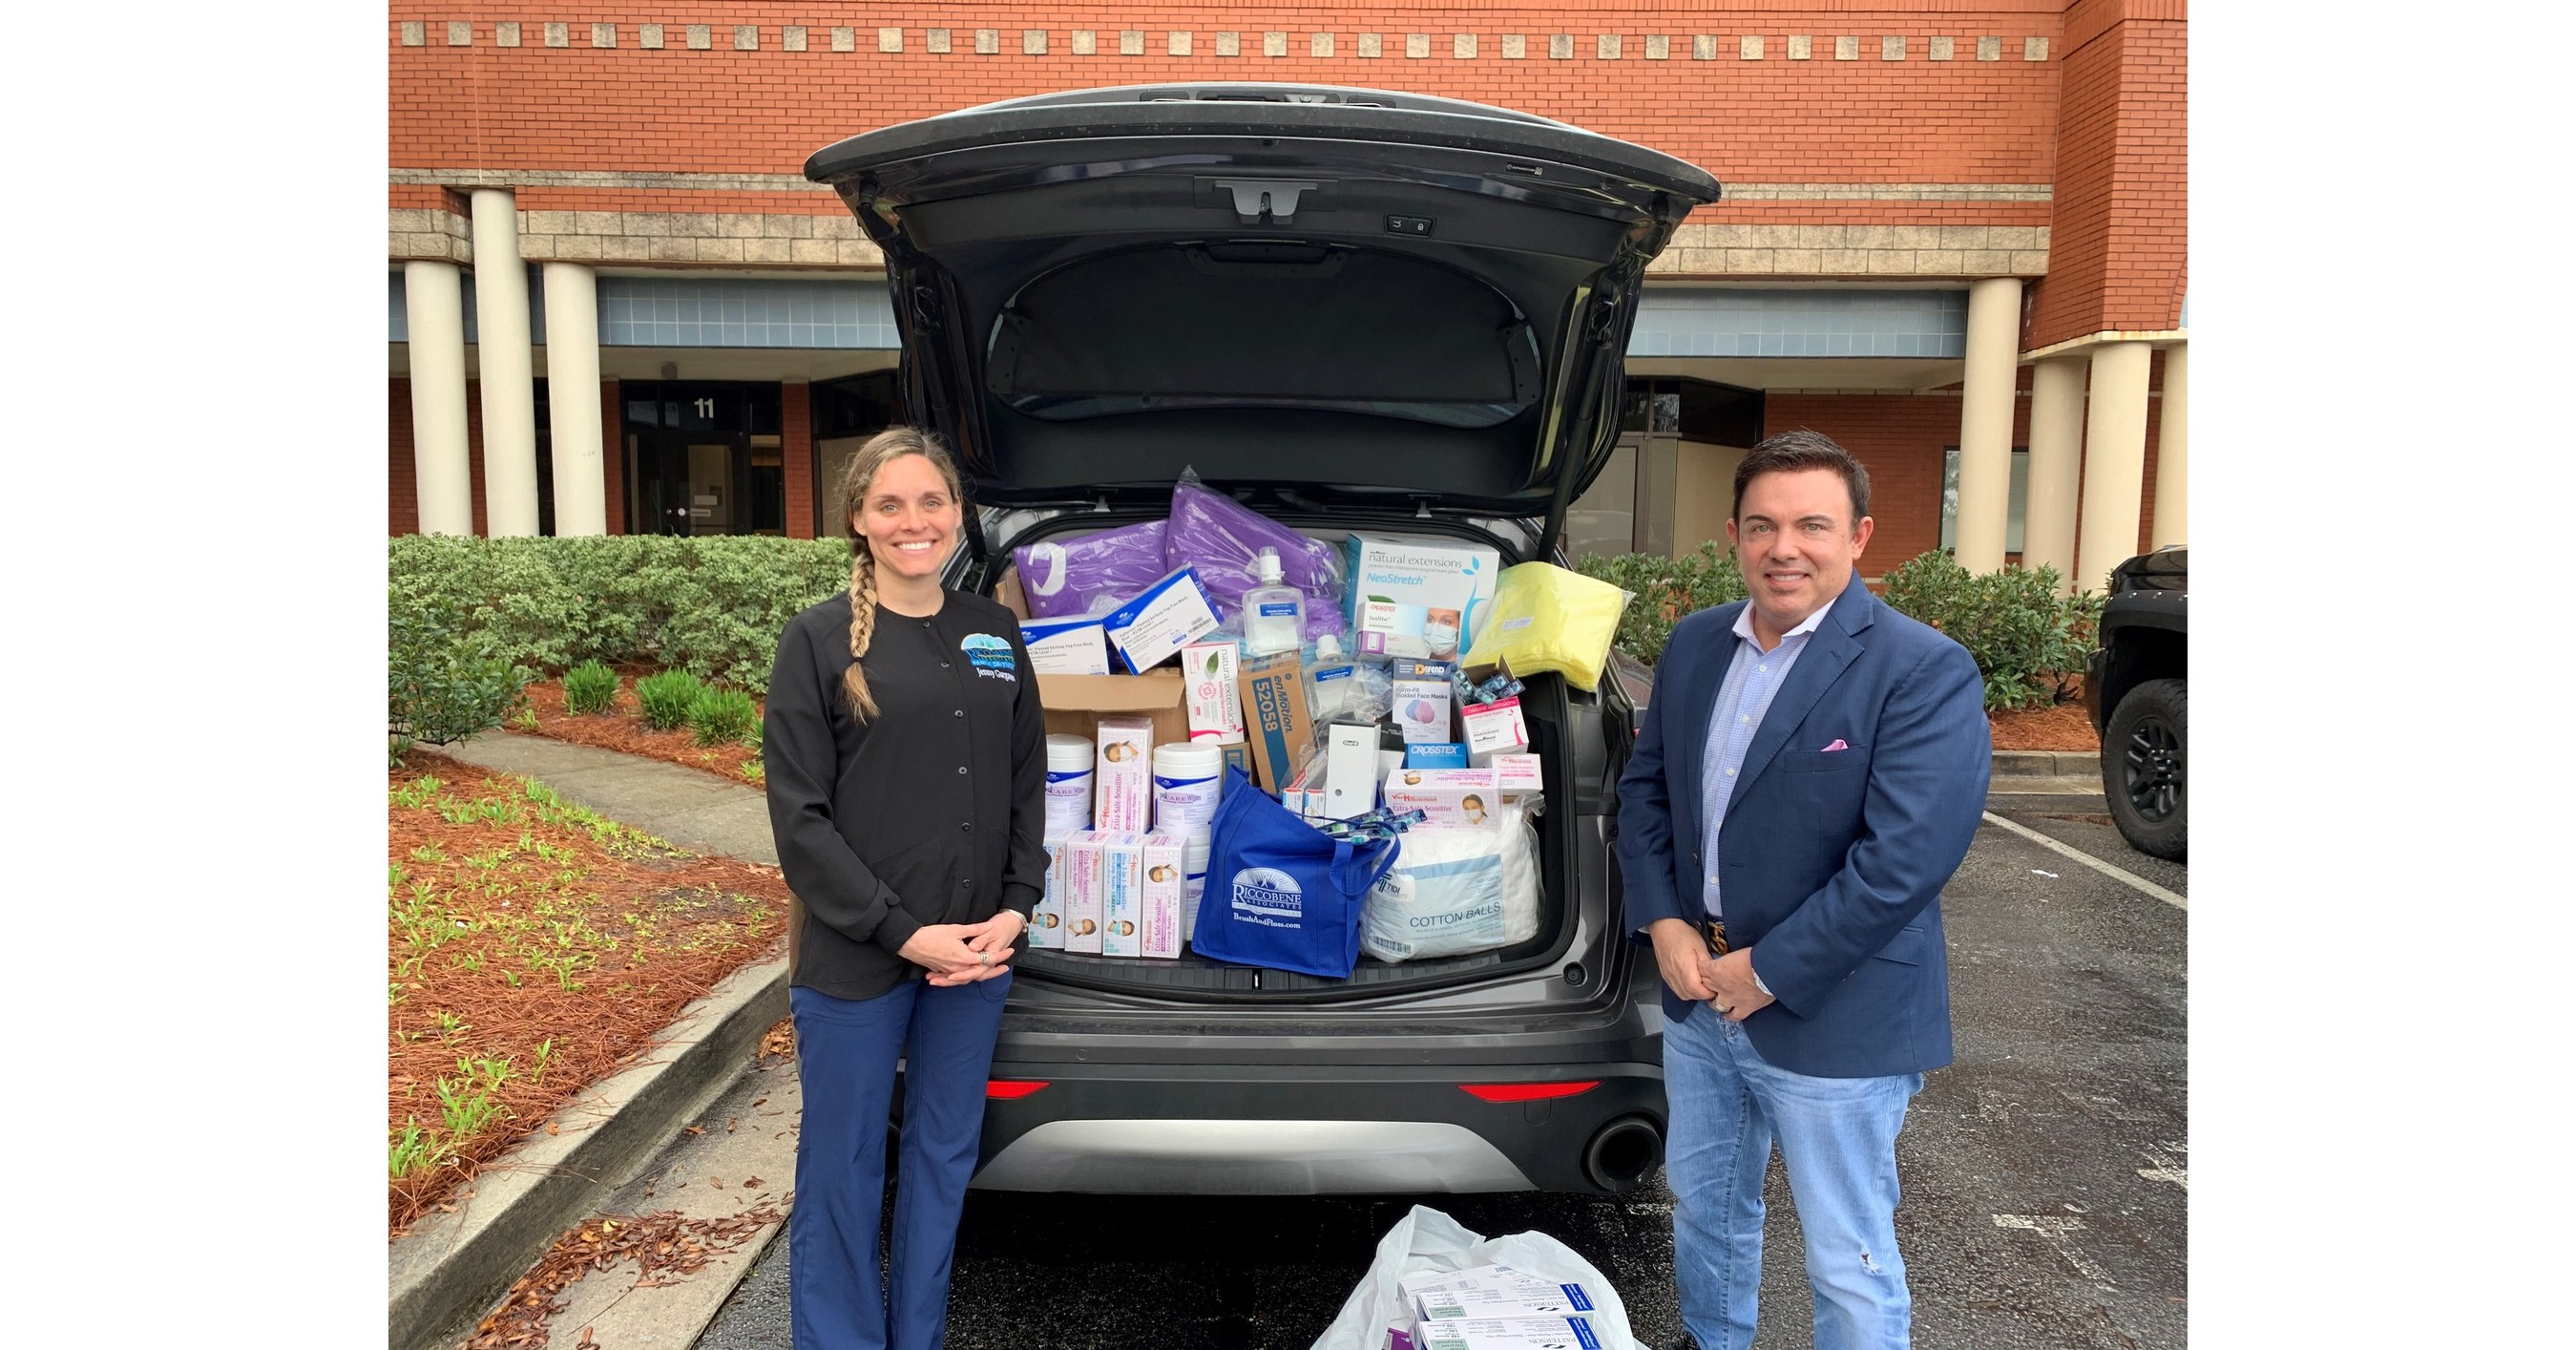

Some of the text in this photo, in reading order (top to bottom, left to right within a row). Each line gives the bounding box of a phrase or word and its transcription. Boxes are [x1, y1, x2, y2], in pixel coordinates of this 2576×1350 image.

[695, 398, 714, 418] 11
[1369, 554, 1462, 568] natural extensions
[1221, 649, 1236, 731] natural extensions
[1256, 682, 1278, 732] 52058
[1274, 675, 1293, 732] enMotion
[1411, 746, 1457, 756] CROSSTEX
[1231, 884, 1301, 905] RICCOBENE
[1387, 882, 1401, 895] TIDI
[1246, 898, 1302, 910] ASSOCIATES
[1233, 912, 1301, 929] BrushAndFloss.com
[1410, 912, 1463, 928] COTTON
[1465, 902, 1501, 919] BALLS
